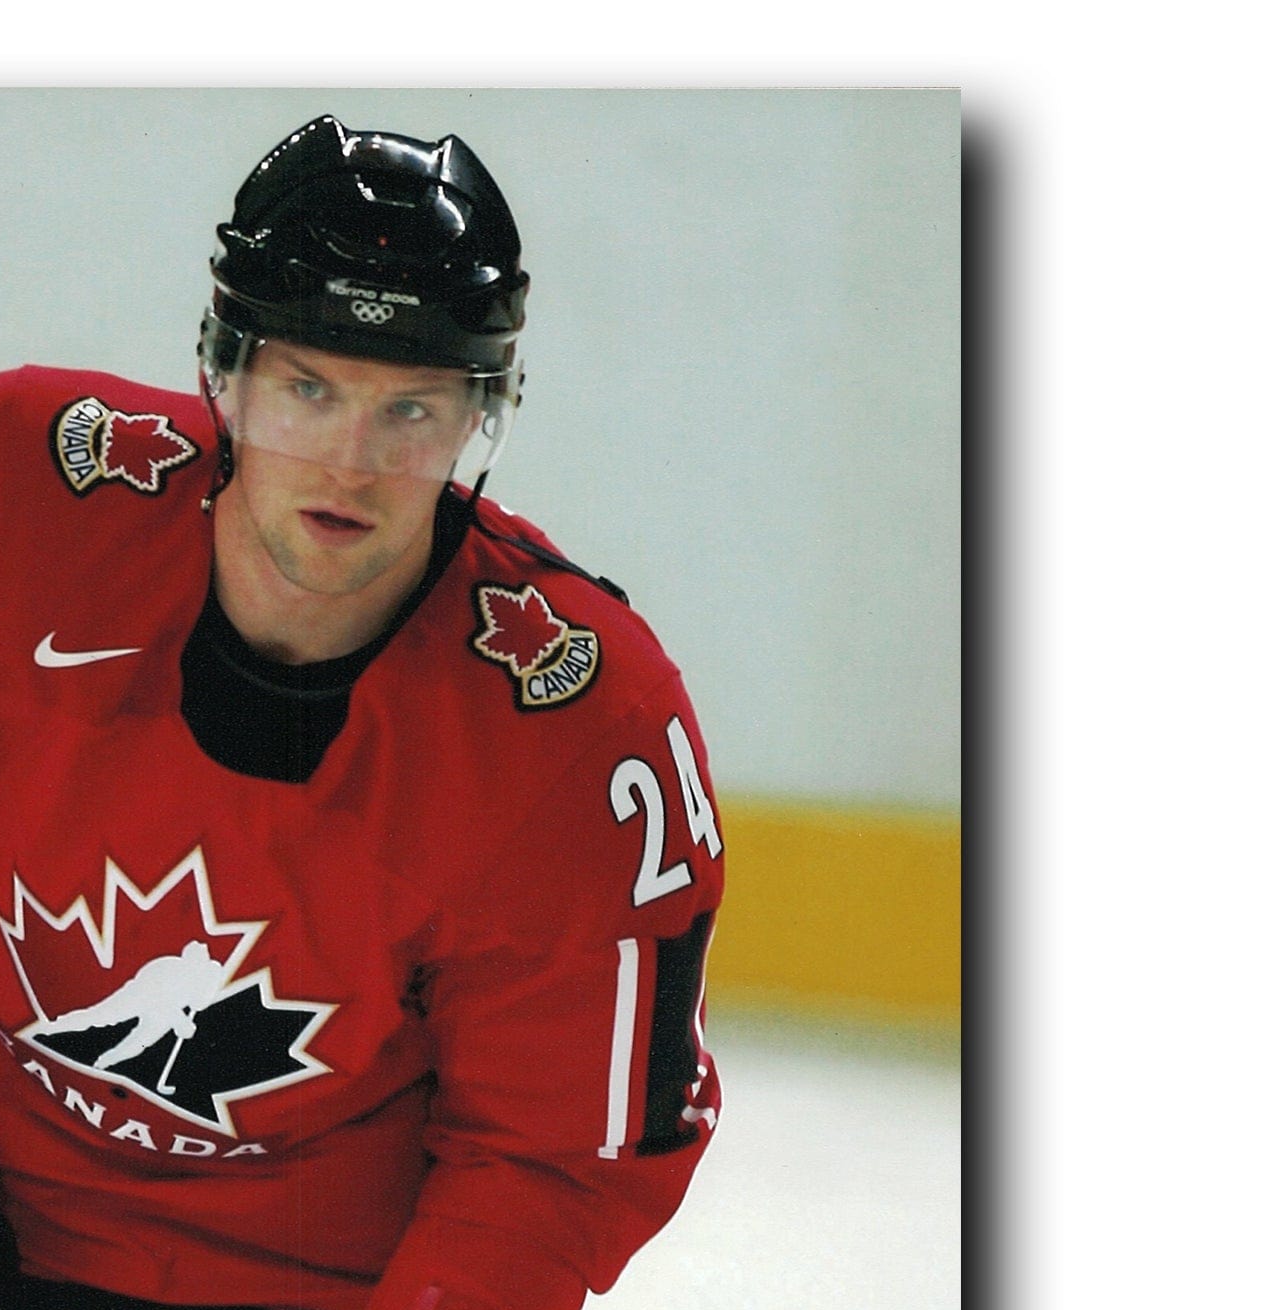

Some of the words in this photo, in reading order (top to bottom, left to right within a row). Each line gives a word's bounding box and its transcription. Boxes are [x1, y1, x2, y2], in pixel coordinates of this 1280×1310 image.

[381, 291, 420, 306] 2006
[63, 401, 105, 484] CANADA
[526, 634, 595, 700] CANADA
[609, 714, 723, 907] 24
